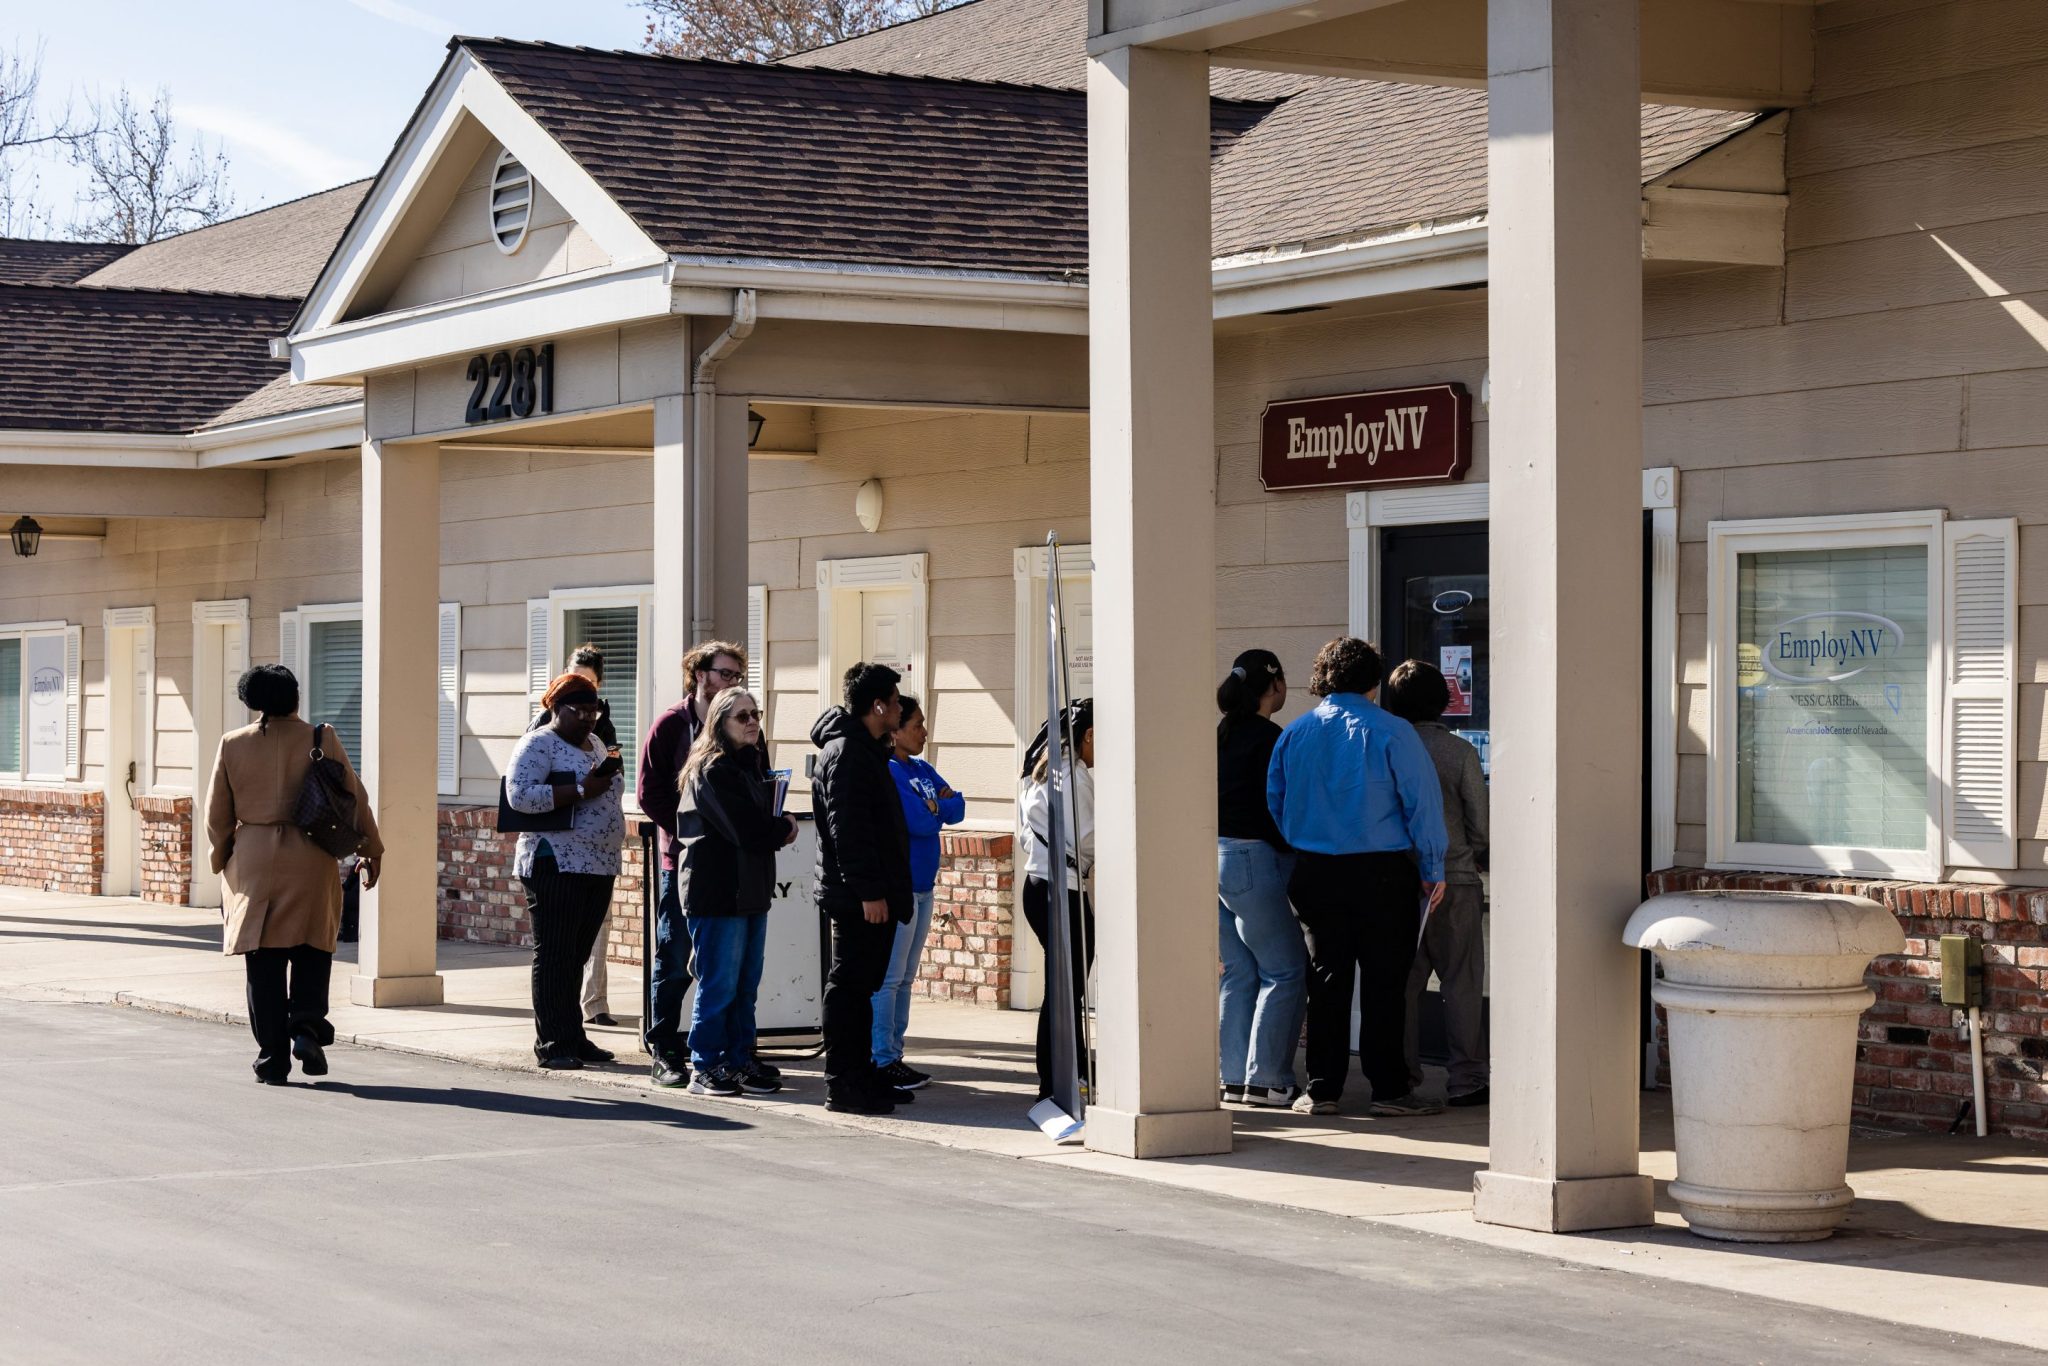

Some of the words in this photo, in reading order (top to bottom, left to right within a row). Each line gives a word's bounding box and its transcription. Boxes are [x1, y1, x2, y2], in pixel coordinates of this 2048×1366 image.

[465, 343, 555, 424] 2281
[1286, 405, 1429, 469] EmployNV
[1779, 629, 1883, 666] EmployNV
[1853, 725, 1861, 735] of
[1861, 726, 1888, 735] Nevada
